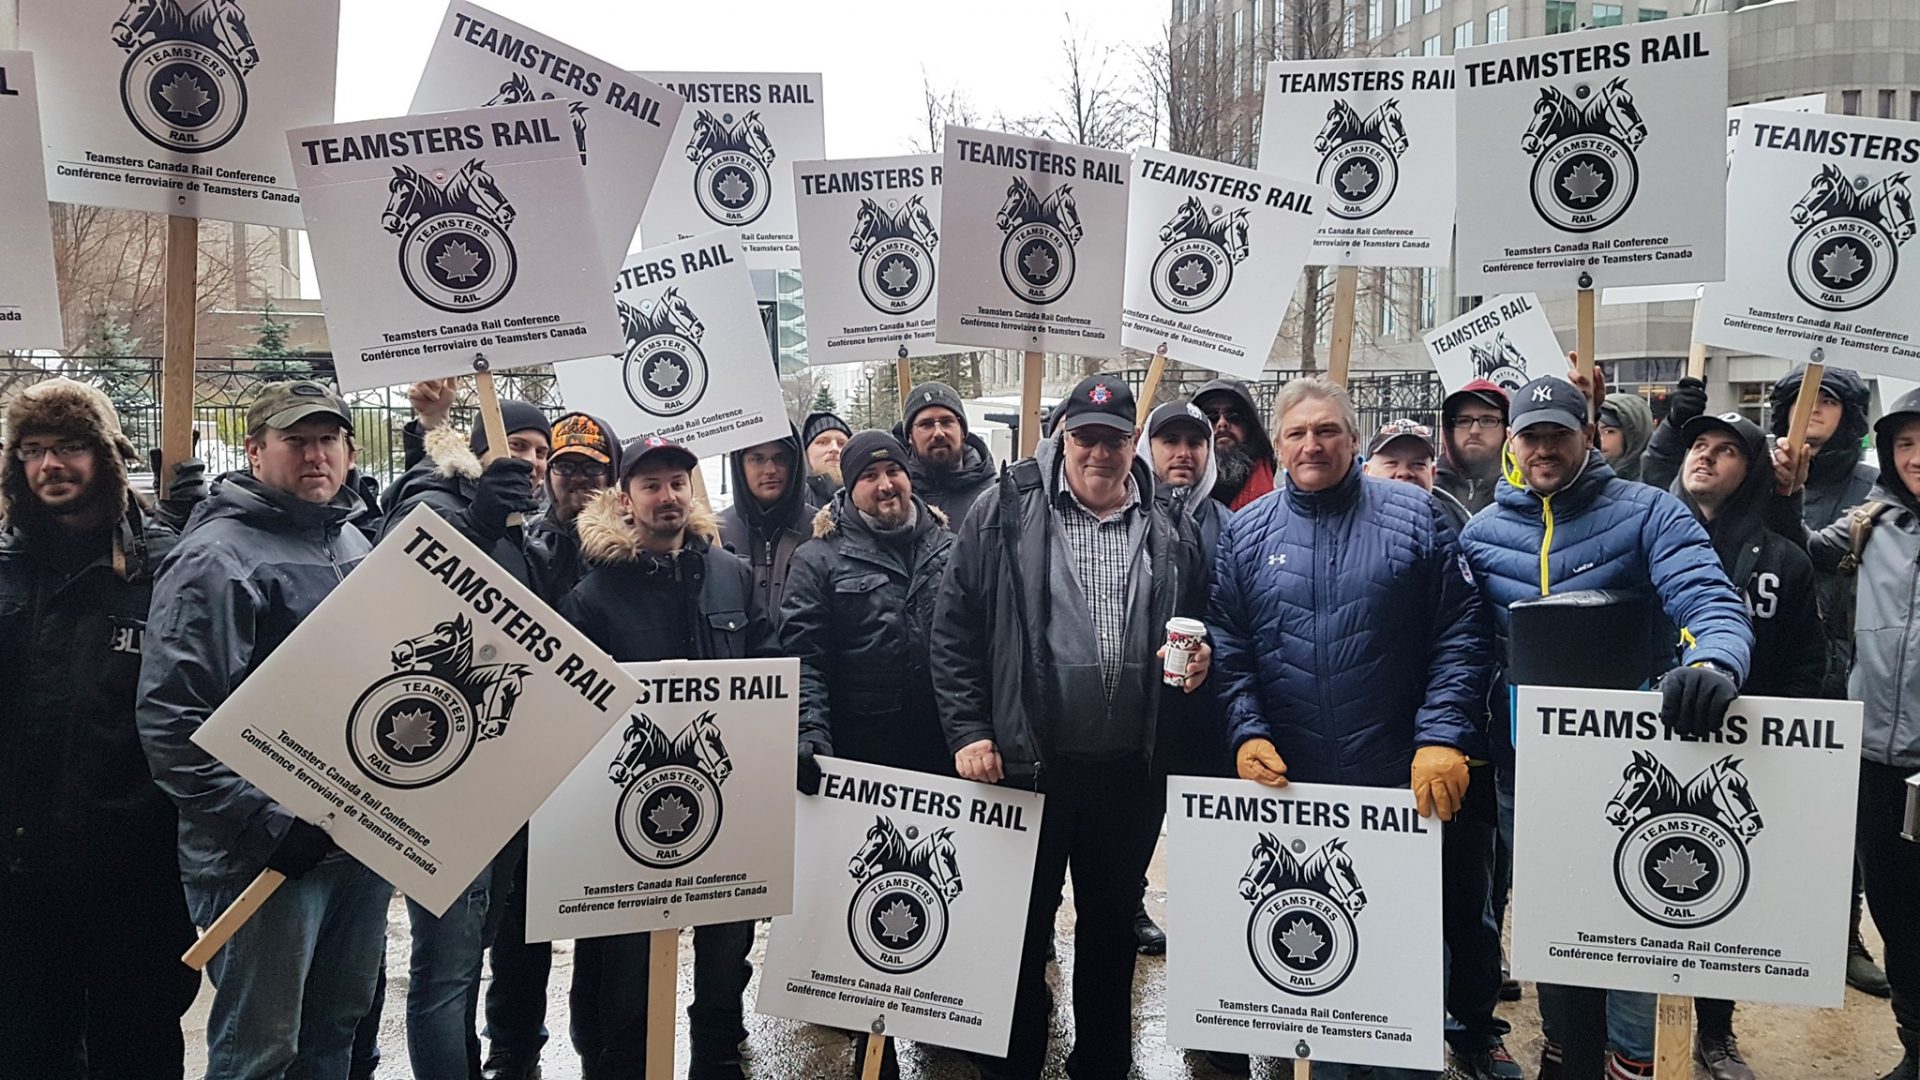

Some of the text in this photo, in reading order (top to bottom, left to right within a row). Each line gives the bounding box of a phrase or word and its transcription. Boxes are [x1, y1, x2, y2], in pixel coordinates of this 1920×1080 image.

[144, 47, 226, 78] TEAMSTERS
[454, 12, 661, 127] TEAMSTERS RAIL
[1464, 32, 1711, 87] TEAMSTERS RAIL
[768, 84, 815, 104] RAIL
[1279, 70, 1405, 93] TEAMSTERS
[169, 130, 199, 143] RAIL
[301, 120, 561, 165] TEAMSTERS RAIL
[1754, 123, 1920, 164] TEAMSTERS
[707, 155, 757, 172] TEAMSTERS
[957, 139, 1076, 177] TEAMSTERS
[1083, 159, 1126, 185] RAIL
[1333, 145, 1386, 163] TEAMSTERS
[1548, 139, 1619, 163] TEAMSTERS
[85, 150, 276, 184] Teamsters Canada Rail Conference
[57, 165, 300, 203] Conférence ferroviaire de Teamsters Canada
[801, 167, 925, 195] TEAMSTERS
[1141, 159, 1313, 215] TEAMSTERS RAIL
[416, 219, 490, 243] TEAMSTERS
[1571, 214, 1597, 224] RAIL
[1015, 227, 1064, 248] TEAMSTERS
[1504, 237, 1668, 257] Teamsters Canada Rail Conference
[1813, 223, 1883, 248] TEAMSTERS
[681, 244, 734, 274] RAIL
[871, 242, 920, 261] TEAMSTERS
[1173, 243, 1224, 266] TEAMSTERS
[1483, 249, 1692, 273] Conférence ferroviaire de Teamsters Canada
[453, 293, 481, 304] RAIL
[1820, 292, 1845, 303] RAIL
[383, 313, 560, 343] Teamsters Canada Rail Conference
[961, 317, 1105, 338] Conférence ferroviaire de Teamsters Canada
[978, 306, 1092, 325] Teamsters Canada Rail Conference
[1430, 296, 1533, 355] TEAMSTERS RAIL
[1749, 307, 1909, 341] Teamsters Canada Rail Conference
[362, 324, 586, 362] Conférence ferroviaire de Teamsters Canada
[1724, 317, 1774, 334] Conférence
[1775, 326, 1824, 342] ferroviaire
[1825, 335, 1838, 344] de
[1840, 337, 1889, 353] Teamsters
[634, 339, 687, 363] TEAMSTERS
[657, 408, 742, 437] Canada Rail Conference
[686, 434, 696, 442] de
[696, 423, 734, 439] Teamsters
[735, 415, 762, 428] Canada
[404, 527, 617, 715] TEAMSTERS RAIL
[730, 675, 790, 701] RAIL
[402, 682, 465, 733] TEAMSTERS
[1538, 707, 1845, 750] TEAMSS RAIL
[367, 753, 391, 775] RAIL
[277, 730, 431, 846] Teamsters Canada Rail Conference
[636, 772, 705, 795] TEAMSTERS
[241, 729, 437, 874] Conférence ferroviaire de Teamsters Canada
[1182, 793, 1428, 834] TEAMSTERS RAIL
[969, 799, 1028, 832] RAIL
[1639, 821, 1726, 848] TEAMSTERS
[656, 849, 682, 859] RAIL
[584, 873, 747, 896] Teamsters Canada Rail Conference
[870, 878, 934, 905] TEAMSTERS
[559, 885, 768, 915] Conférence ferroviaire de Teamsters Canada
[1266, 896, 1338, 921] TEAMSTERS
[1663, 906, 1696, 918] RAIL
[1577, 931, 1782, 957] Teamsters Canada Rail Conference
[879, 952, 904, 964] RAIL
[1549, 947, 1809, 977] Conférence ferroviaire de Teamsters Canada
[811, 969, 964, 1006] Teamsters Canada Rail Conference
[1289, 975, 1316, 986] RAIL
[786, 982, 982, 1025] Conférence ferroviaire de Teamsters Canada
[1219, 999, 1388, 1023] Teamsters Canada Rail Conference
[1195, 1013, 1412, 1042] Conférence ferroviaire de Teamsters Canada
